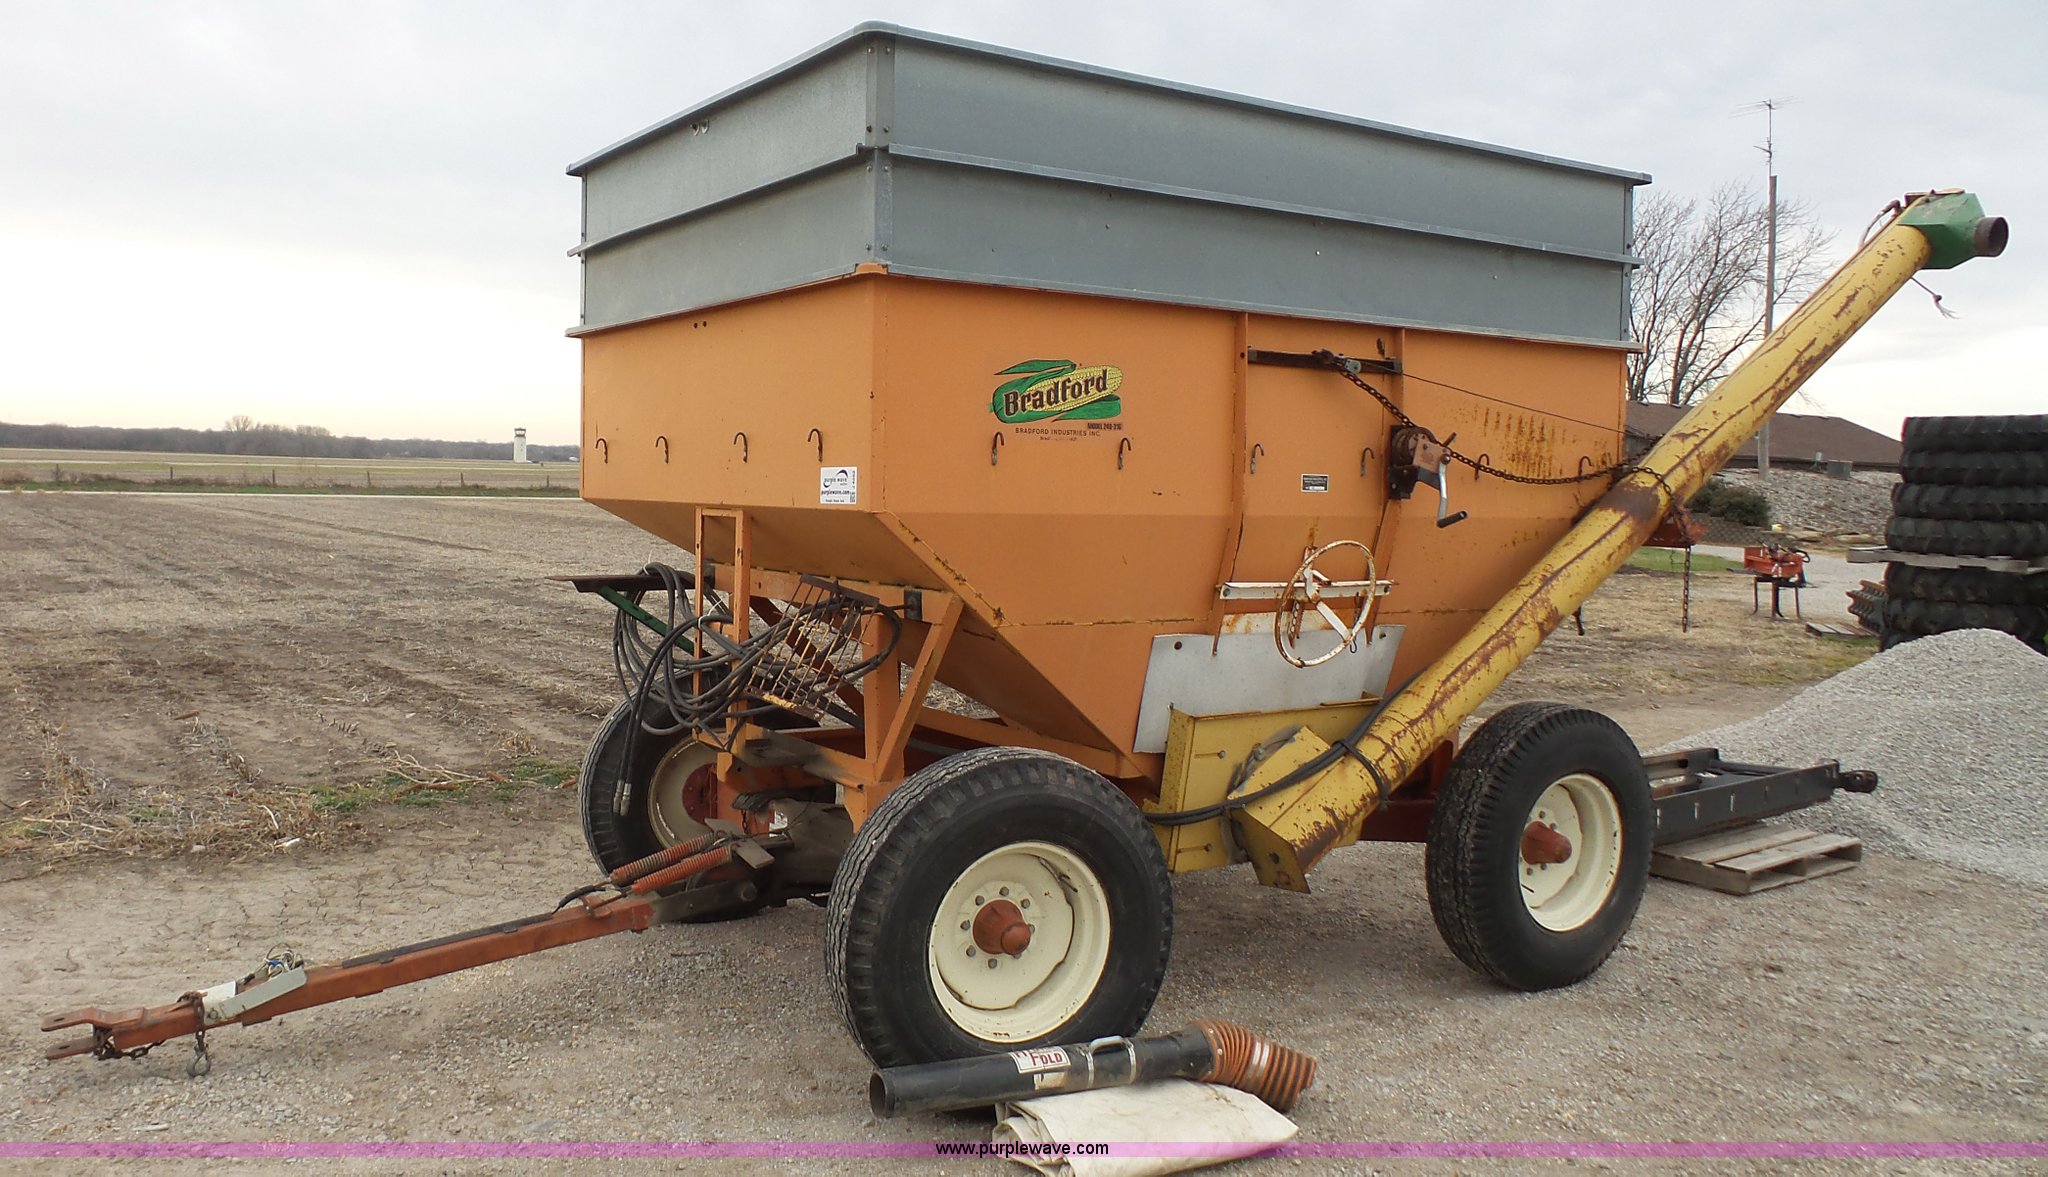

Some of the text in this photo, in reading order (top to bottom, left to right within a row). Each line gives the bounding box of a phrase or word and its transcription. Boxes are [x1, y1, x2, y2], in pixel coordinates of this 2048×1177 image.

[1003, 369, 1108, 416] Bradford
[1015, 427, 1049, 435] BRADFORD
[1050, 429, 1087, 437] INDUSTRIES
[1029, 1051, 1062, 1066] FOLD
